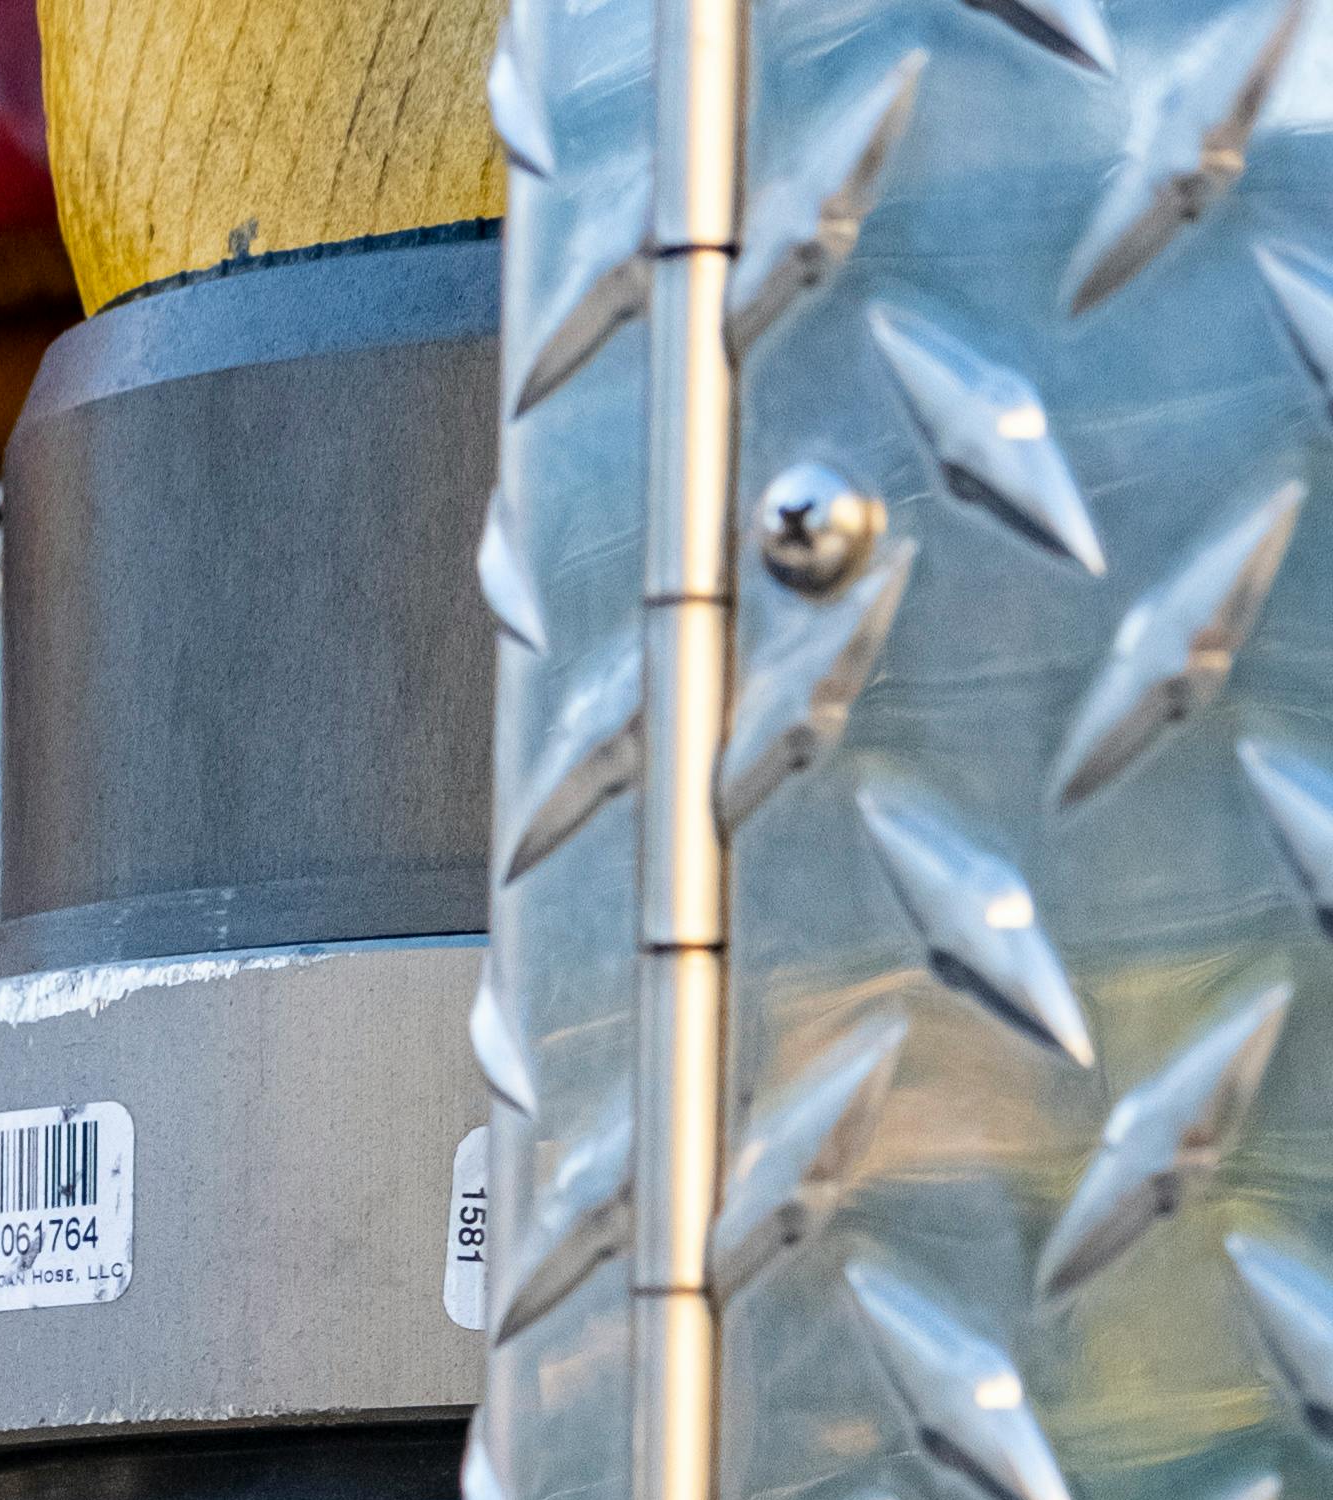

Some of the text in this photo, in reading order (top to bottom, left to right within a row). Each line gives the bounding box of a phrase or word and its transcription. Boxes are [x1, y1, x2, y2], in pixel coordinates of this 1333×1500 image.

[457, 1187, 486, 1263] 1581
[32, 1268, 80, 1285] HOSE,
[88, 1262, 124, 1280] LLC
